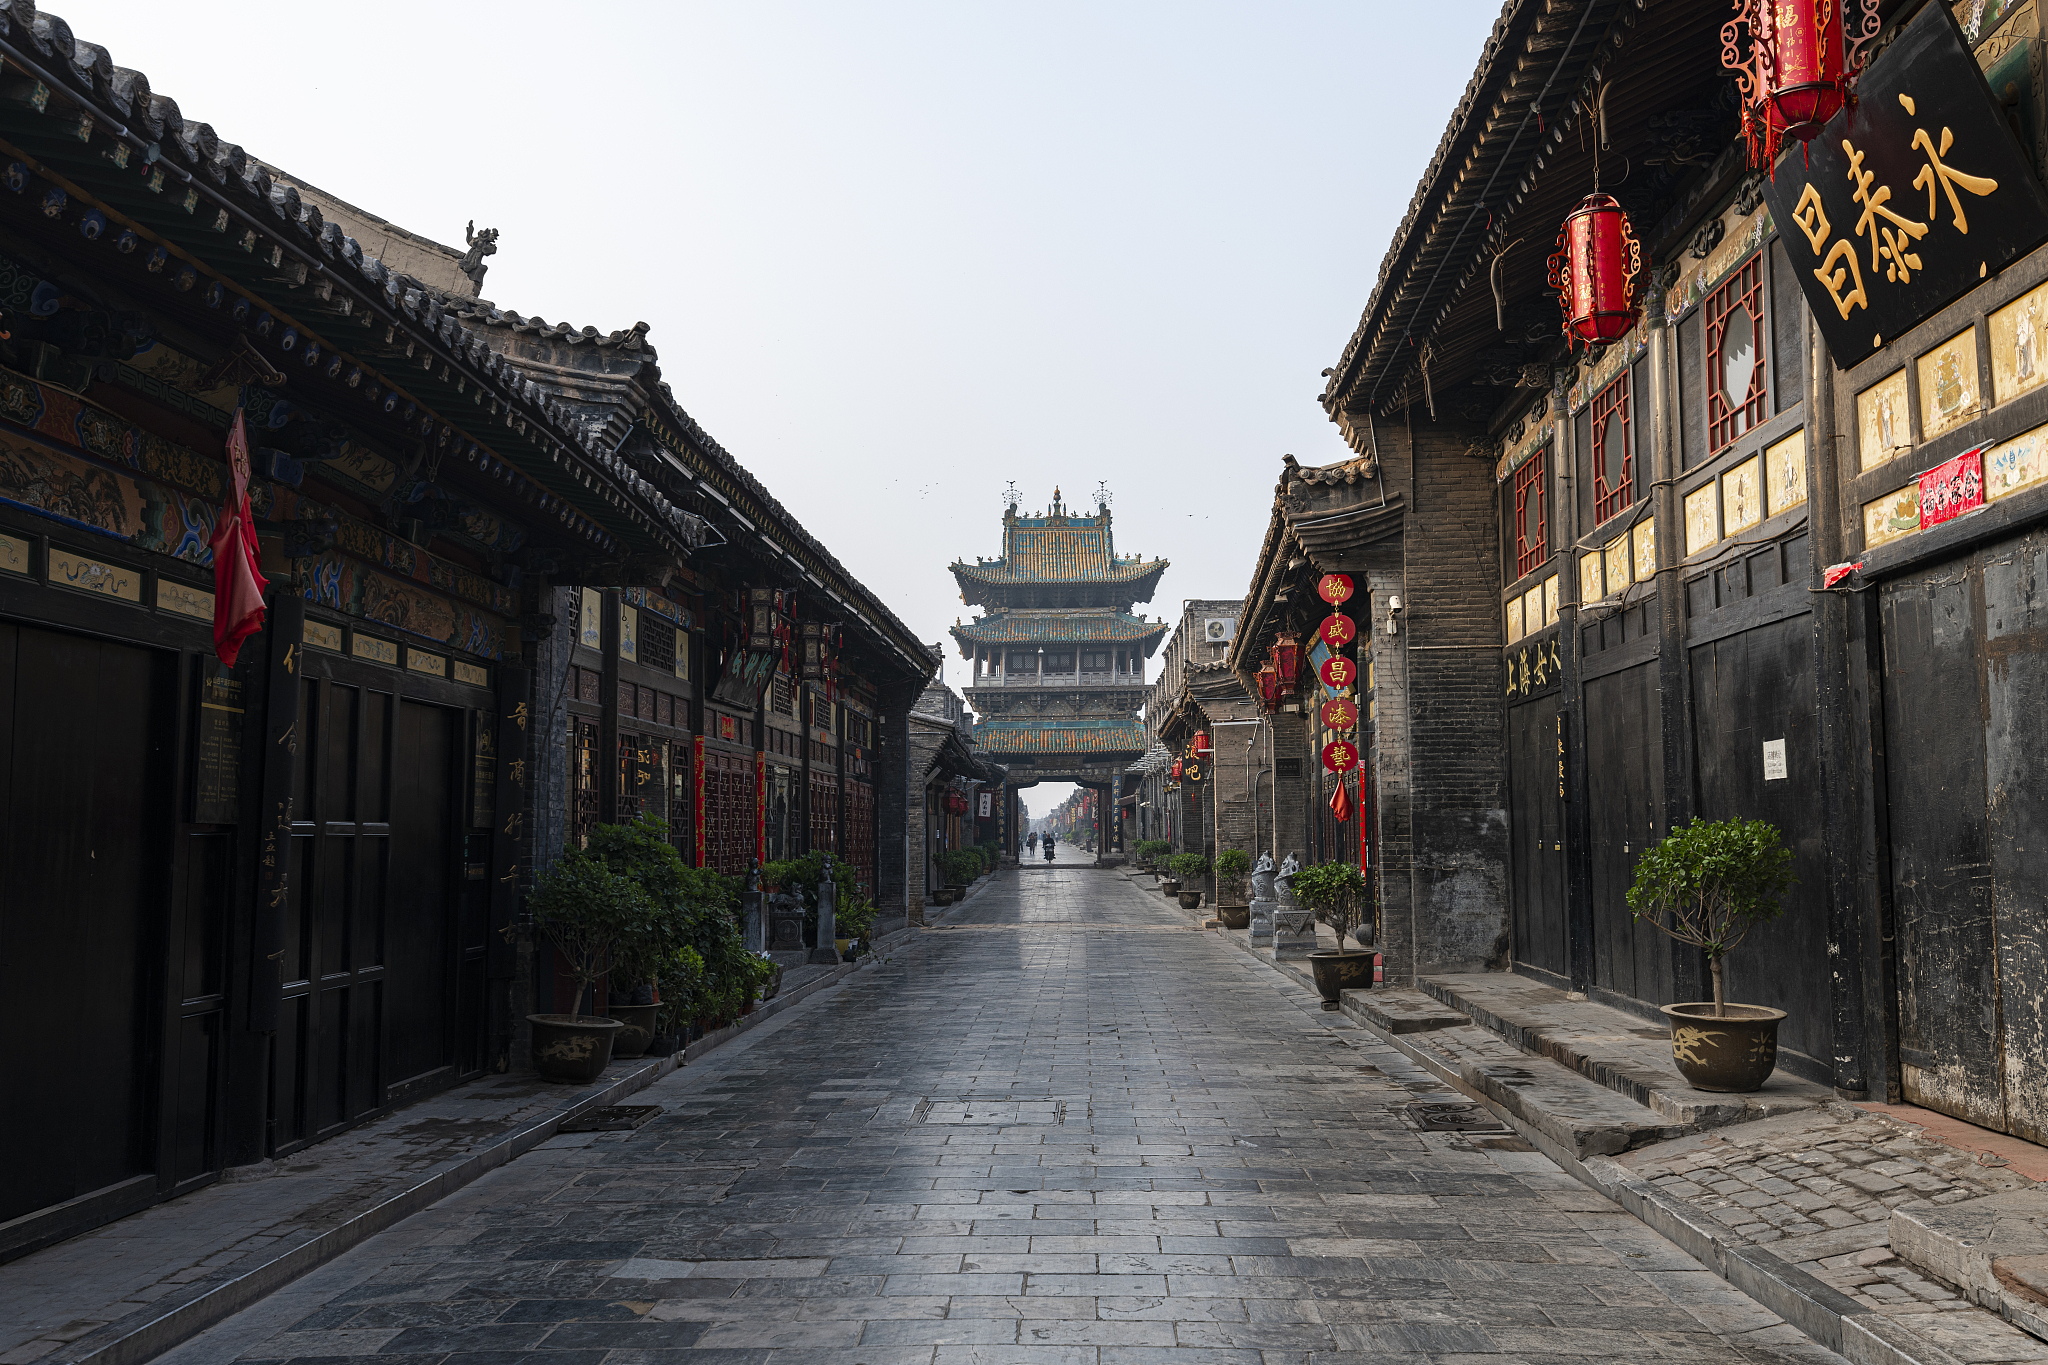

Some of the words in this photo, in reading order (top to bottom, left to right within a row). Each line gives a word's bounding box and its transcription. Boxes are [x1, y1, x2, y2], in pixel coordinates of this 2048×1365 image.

[1792, 93, 1998, 321] 永泰昌
[1507, 632, 1561, 696] 上海女人
